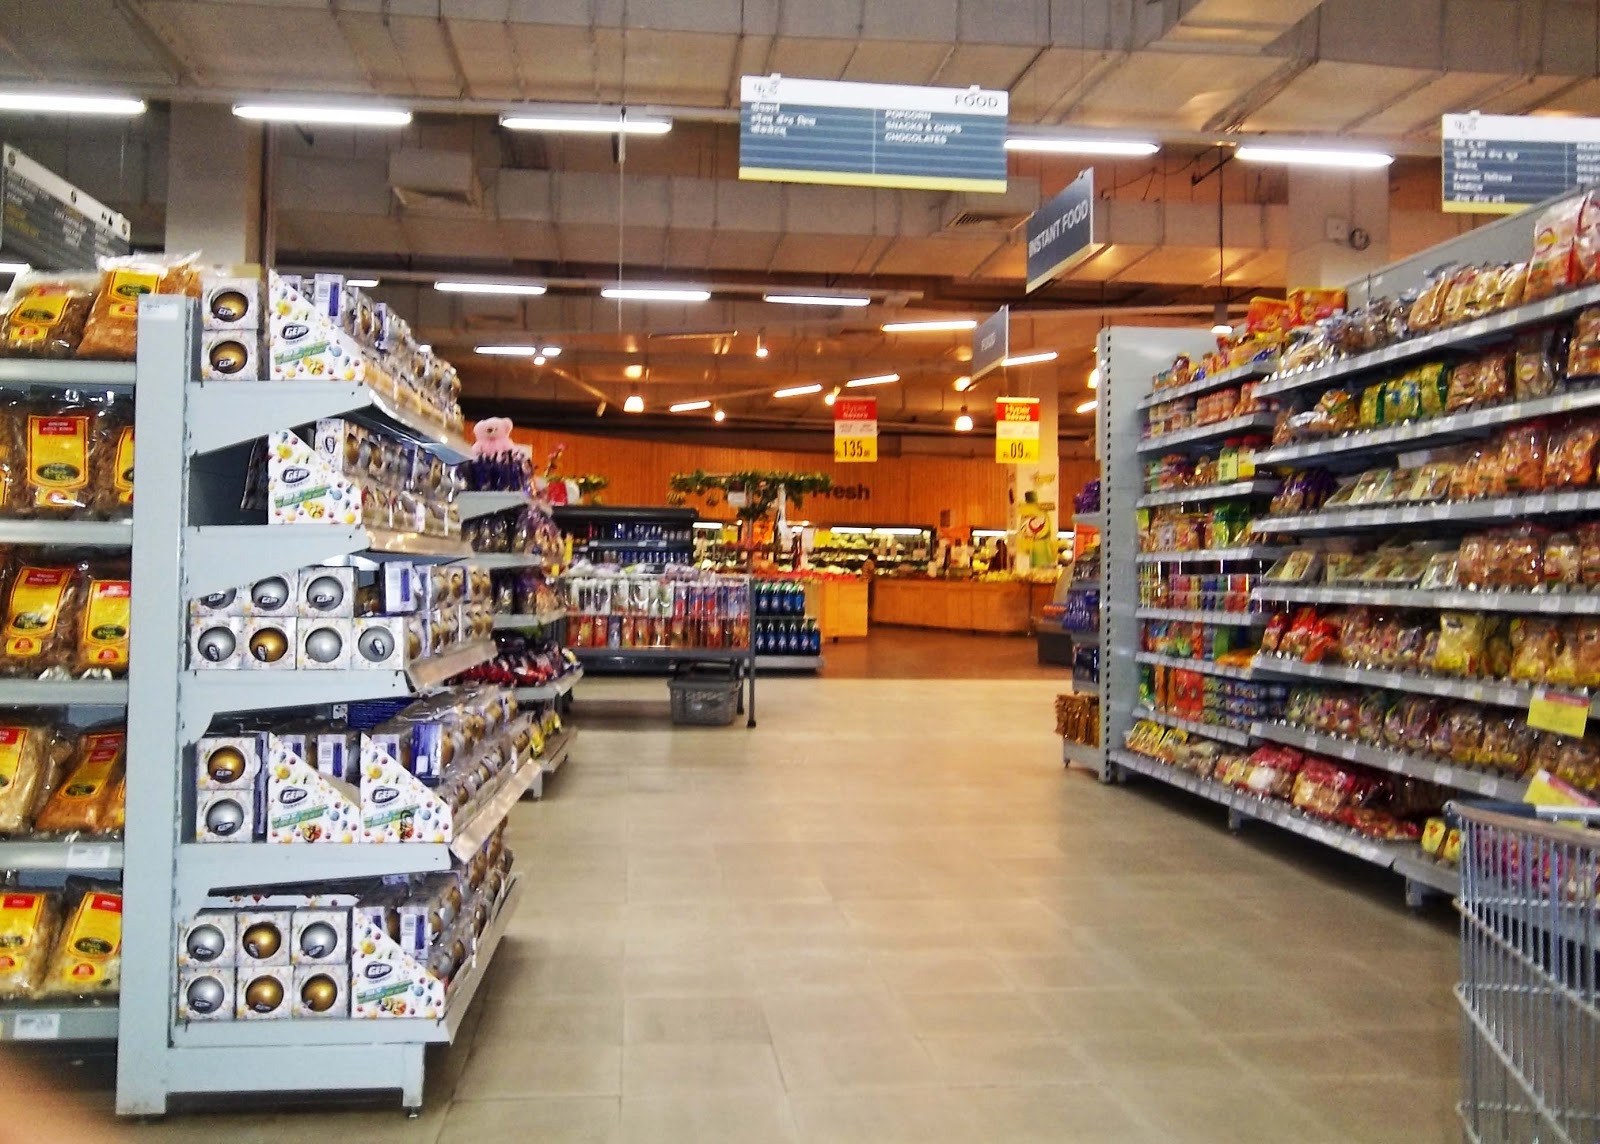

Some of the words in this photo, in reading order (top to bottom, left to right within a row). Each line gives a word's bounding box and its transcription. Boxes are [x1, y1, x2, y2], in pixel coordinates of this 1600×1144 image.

[955, 94, 998, 108] FOOD
[885, 109, 931, 121] POPCORN
[885, 121, 924, 132] SNACKS
[925, 122, 932, 132] &
[933, 123, 962, 134] CHIPS
[884, 132, 947, 144] CHOCOLATES
[1062, 199, 1089, 234] FOOD
[1005, 403, 1030, 415] Hyper
[843, 440, 863, 457] 135
[1010, 442, 1024, 459] 09
